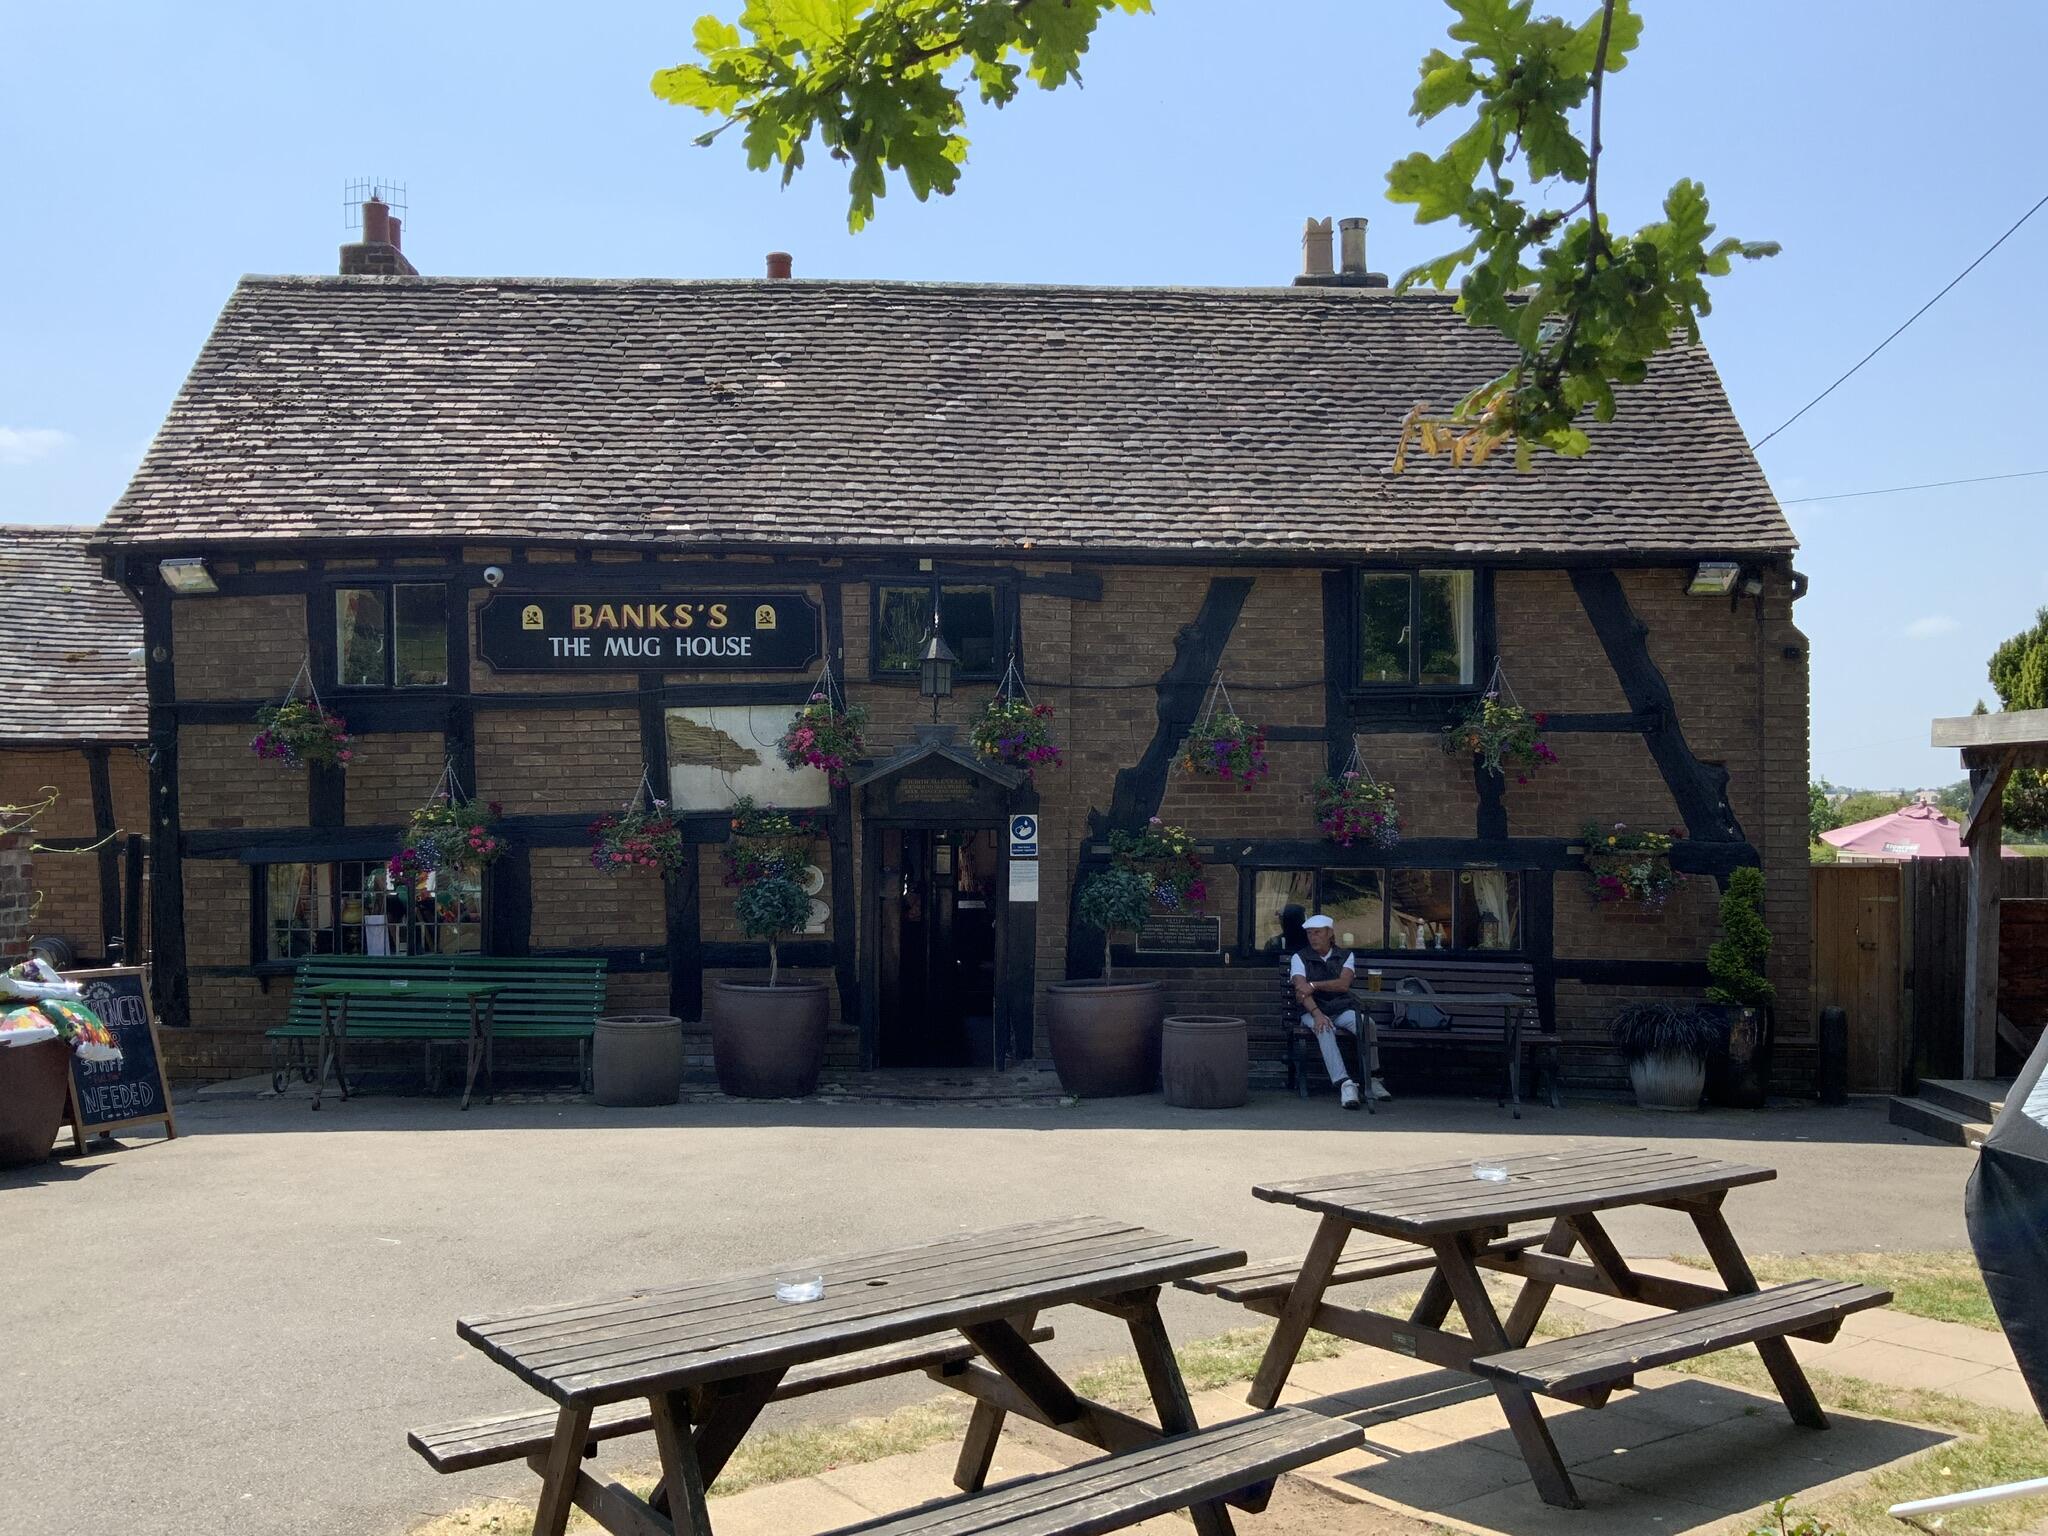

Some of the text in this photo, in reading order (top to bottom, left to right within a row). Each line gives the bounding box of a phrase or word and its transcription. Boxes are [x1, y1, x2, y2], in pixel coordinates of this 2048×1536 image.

[572, 603, 728, 630] BANKS'S
[548, 636, 752, 657] THE MUG HOUSE
[82, 1082, 154, 1114] NEEDED
